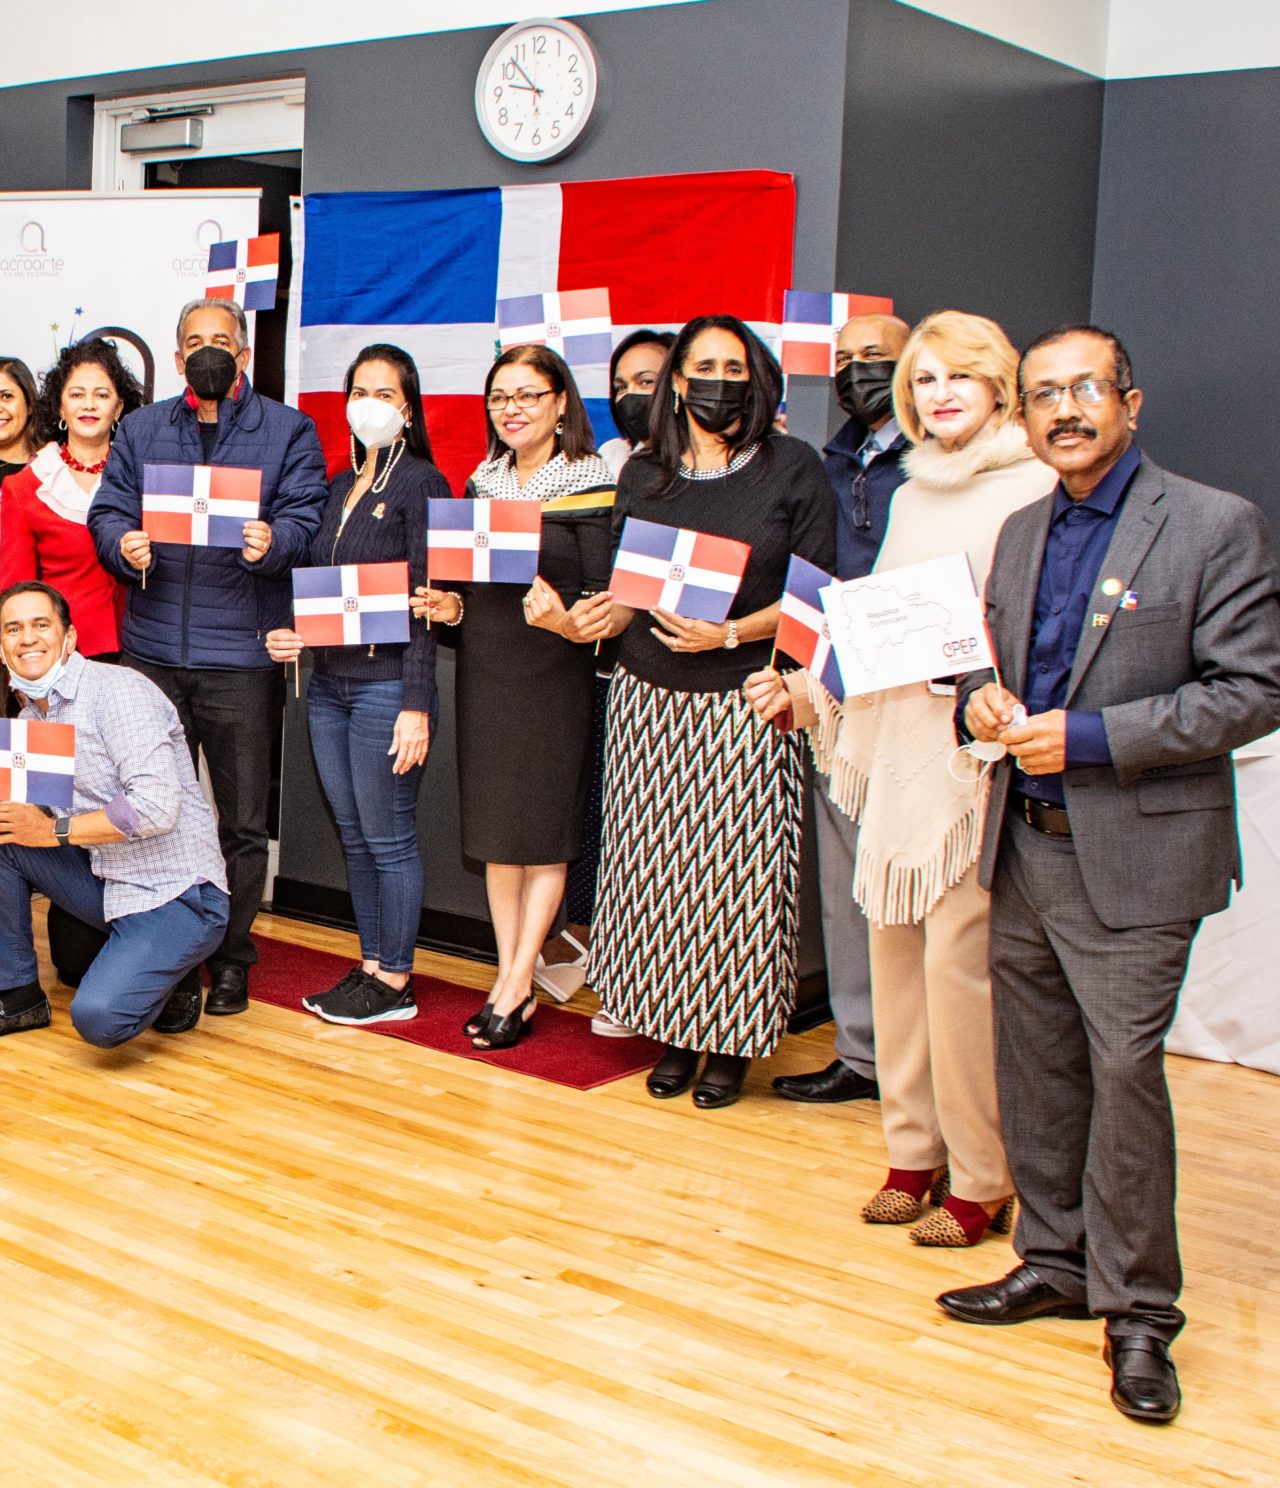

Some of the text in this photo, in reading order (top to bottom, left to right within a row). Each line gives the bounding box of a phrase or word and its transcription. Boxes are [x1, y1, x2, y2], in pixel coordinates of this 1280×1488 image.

[514, 43, 526, 62] 11
[531, 35, 547, 55] 12
[501, 62, 516, 81] 10
[568, 54, 577, 73] 2
[493, 86, 503, 104] 9
[573, 77, 582, 96] 3
[498, 107, 508, 126] 8
[565, 102, 574, 118] 4
[514, 122, 524, 141] 7
[531, 127, 541, 146] 6
[551, 120, 560, 138] 5
[0, 257, 65, 271] acroarte
[172, 258, 209, 271] acro
[943, 637, 978, 657] CPEP
